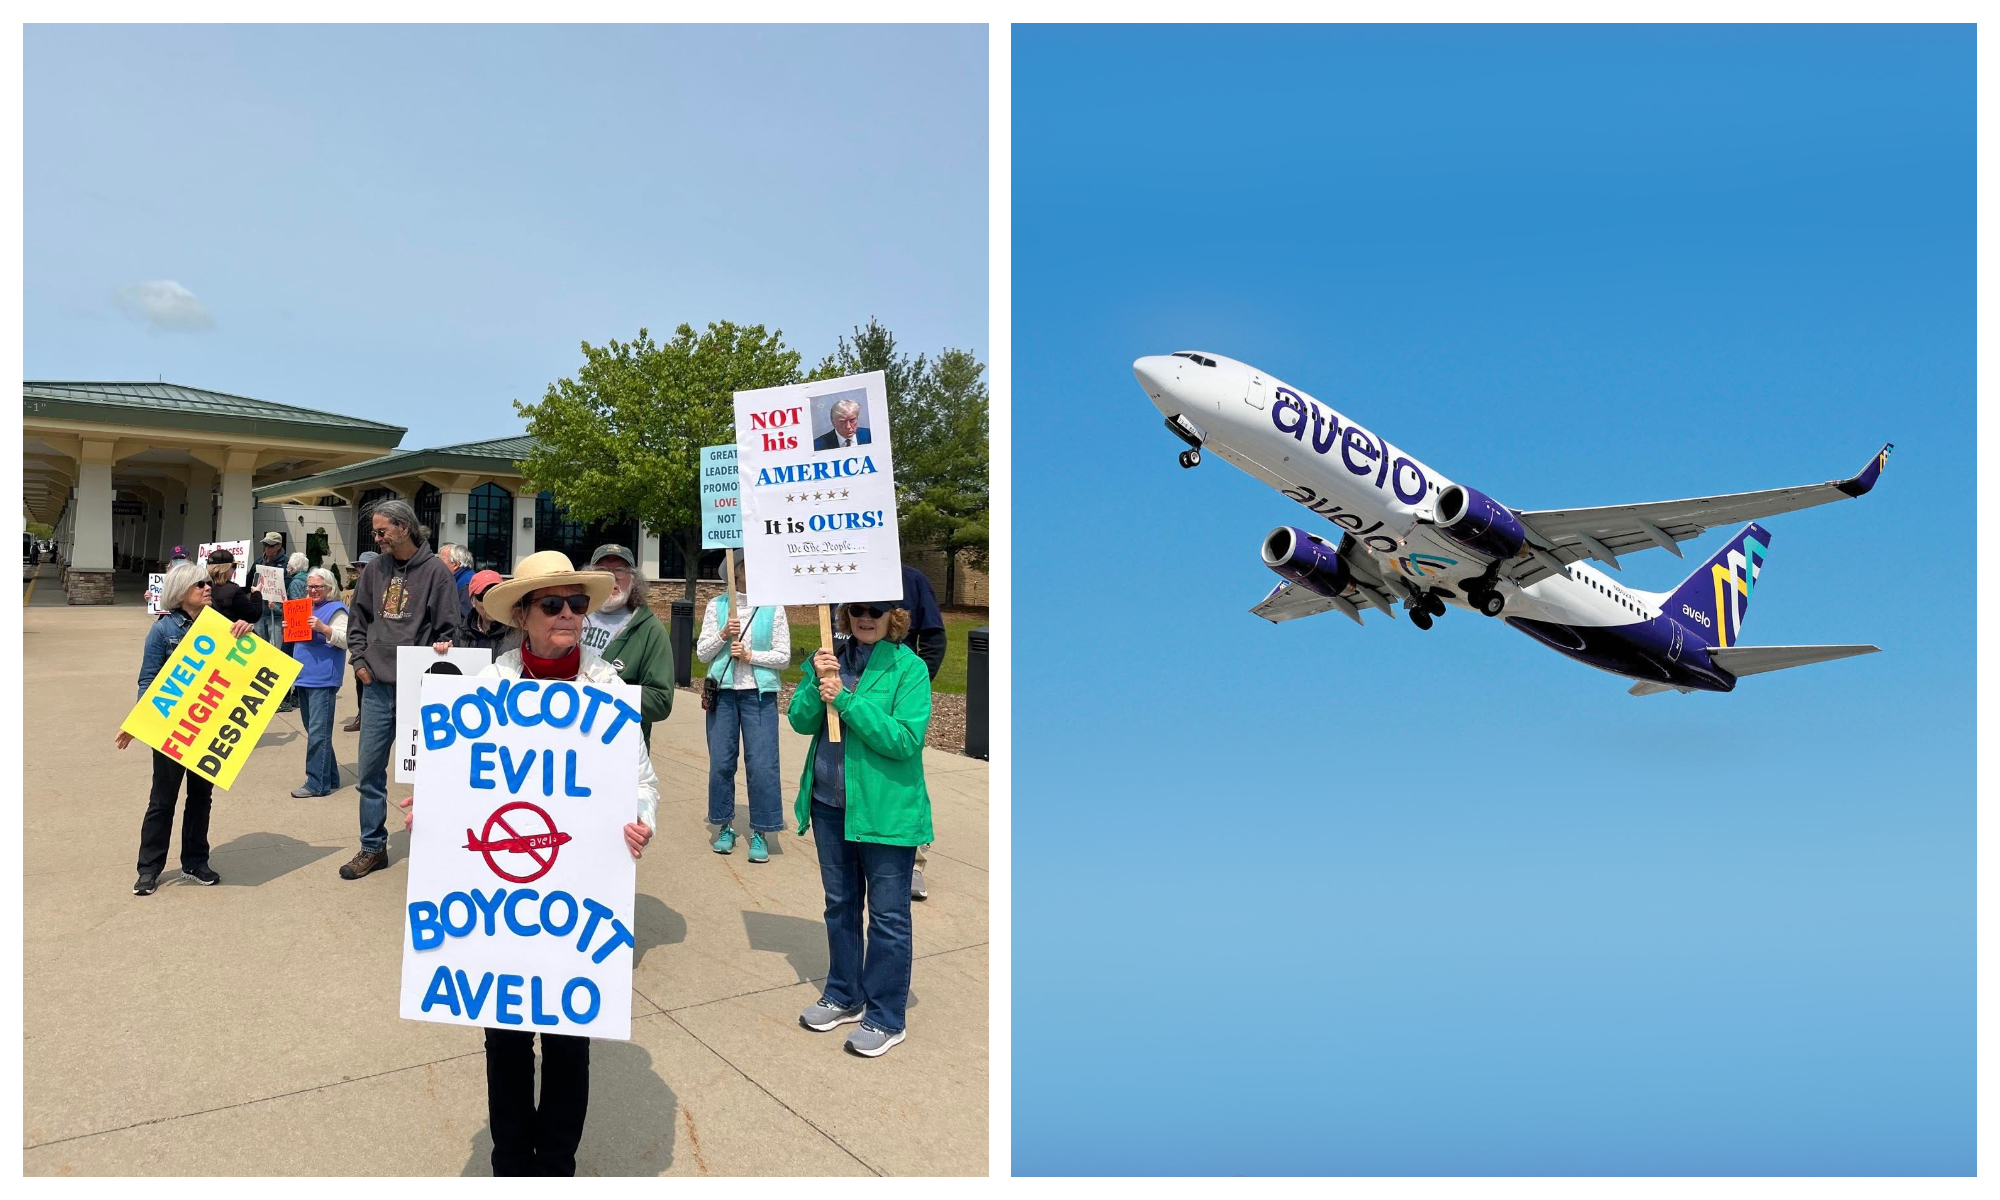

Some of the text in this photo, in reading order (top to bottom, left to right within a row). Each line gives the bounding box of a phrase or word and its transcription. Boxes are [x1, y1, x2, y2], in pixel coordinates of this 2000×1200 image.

[750, 407, 802, 430] NOT
[762, 431, 798, 452] his
[1271, 386, 1427, 505] avelo
[710, 449, 738, 461] GREAT
[705, 465, 739, 477] LEADER
[755, 456, 878, 487] AMERICA
[703, 482, 740, 494] PROMO
[714, 498, 738, 508] LOVE
[717, 514, 736, 524] NOT
[764, 510, 884, 535] It is OURS!
[1281, 485, 1398, 554] avelo
[708, 529, 743, 540] CRUELT
[787, 543, 801, 554] We
[803, 541, 820, 553] The
[263, 569, 278, 580] LOVE
[1682, 604, 1711, 628] avelo
[152, 635, 216, 719] AVELO
[161, 634, 257, 761] FLIGHT TO
[196, 666, 280, 778] DESPAIR
[421, 678, 642, 751] BOYCOTT
[469, 742, 592, 798] EVIL
[408, 888, 635, 965] BOYCOTT
[421, 965, 601, 1026] AVELO
